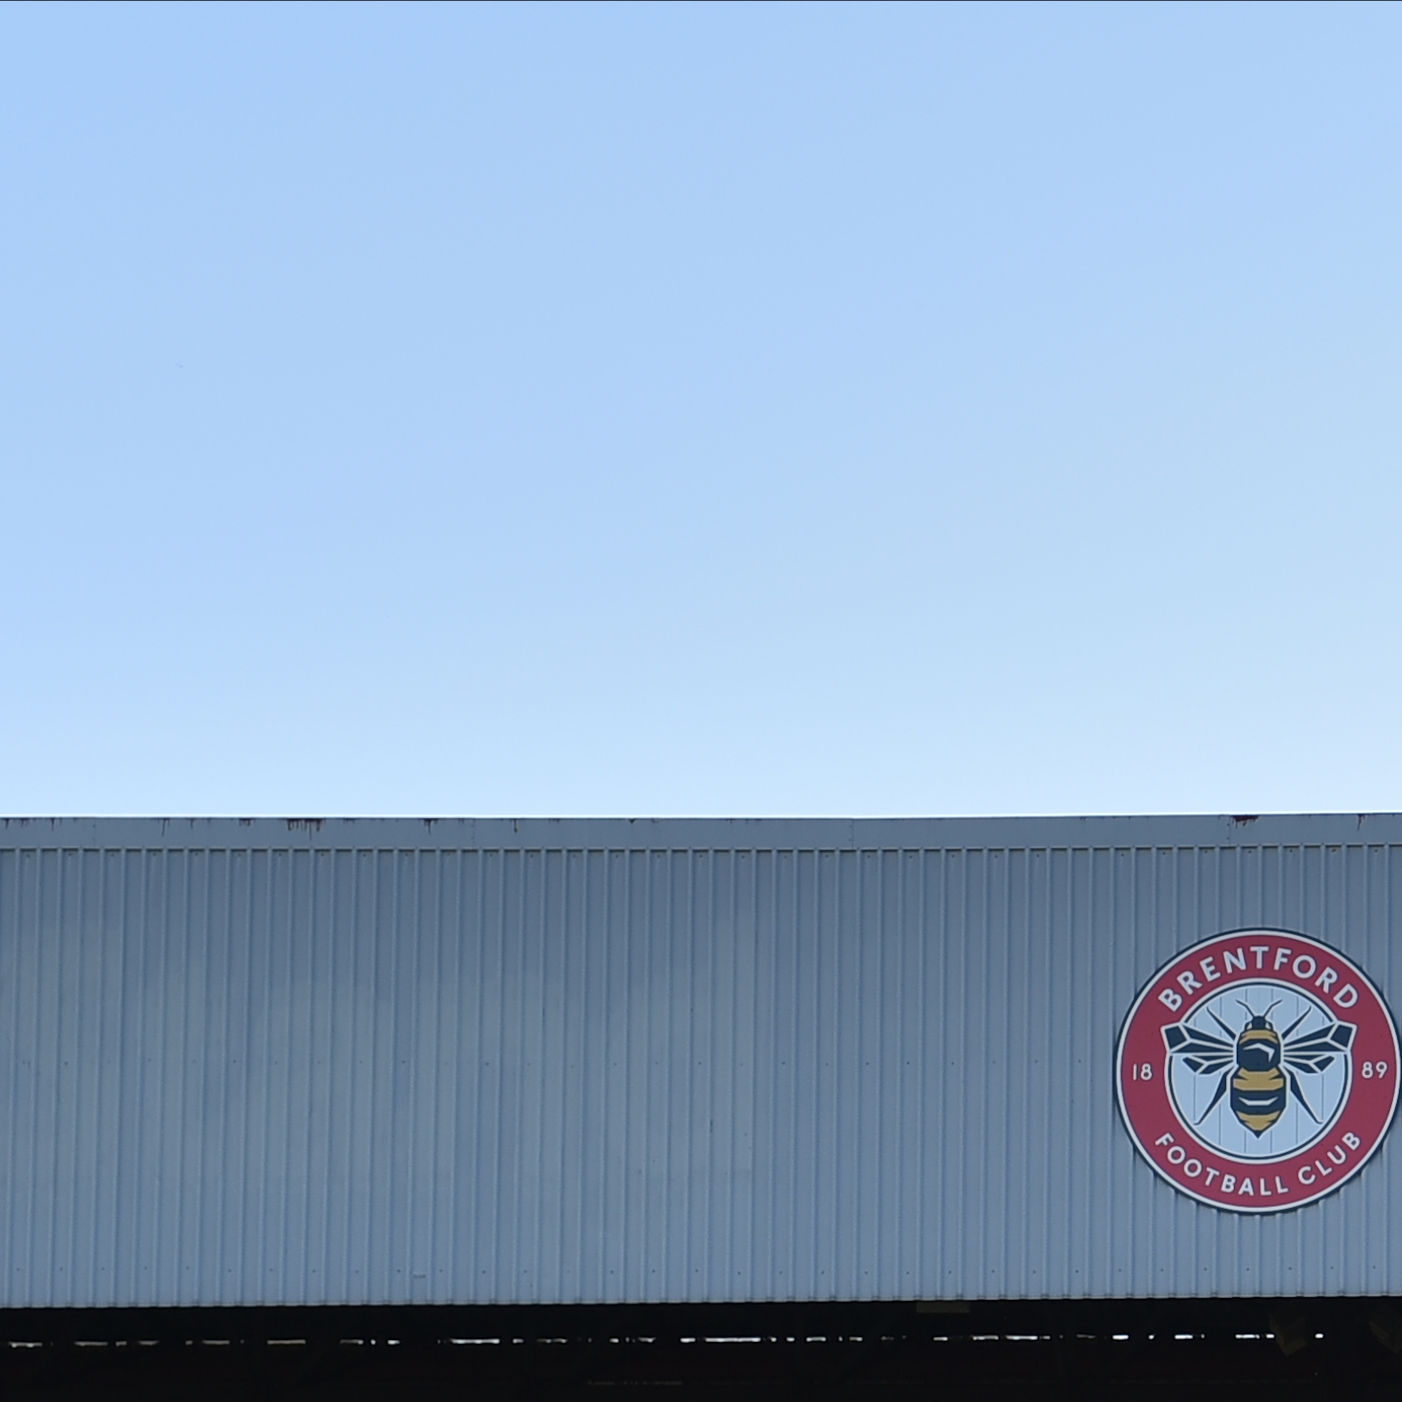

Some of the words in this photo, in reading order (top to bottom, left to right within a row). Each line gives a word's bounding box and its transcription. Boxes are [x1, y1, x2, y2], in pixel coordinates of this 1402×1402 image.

[1158, 946, 1358, 1012] BRENTFORD
[1132, 1063, 1153, 1081] 18
[1361, 1062, 1387, 1079] 89
[1155, 1132, 1289, 1196] FOOTBALL
[1297, 1131, 1361, 1186] CLUB
